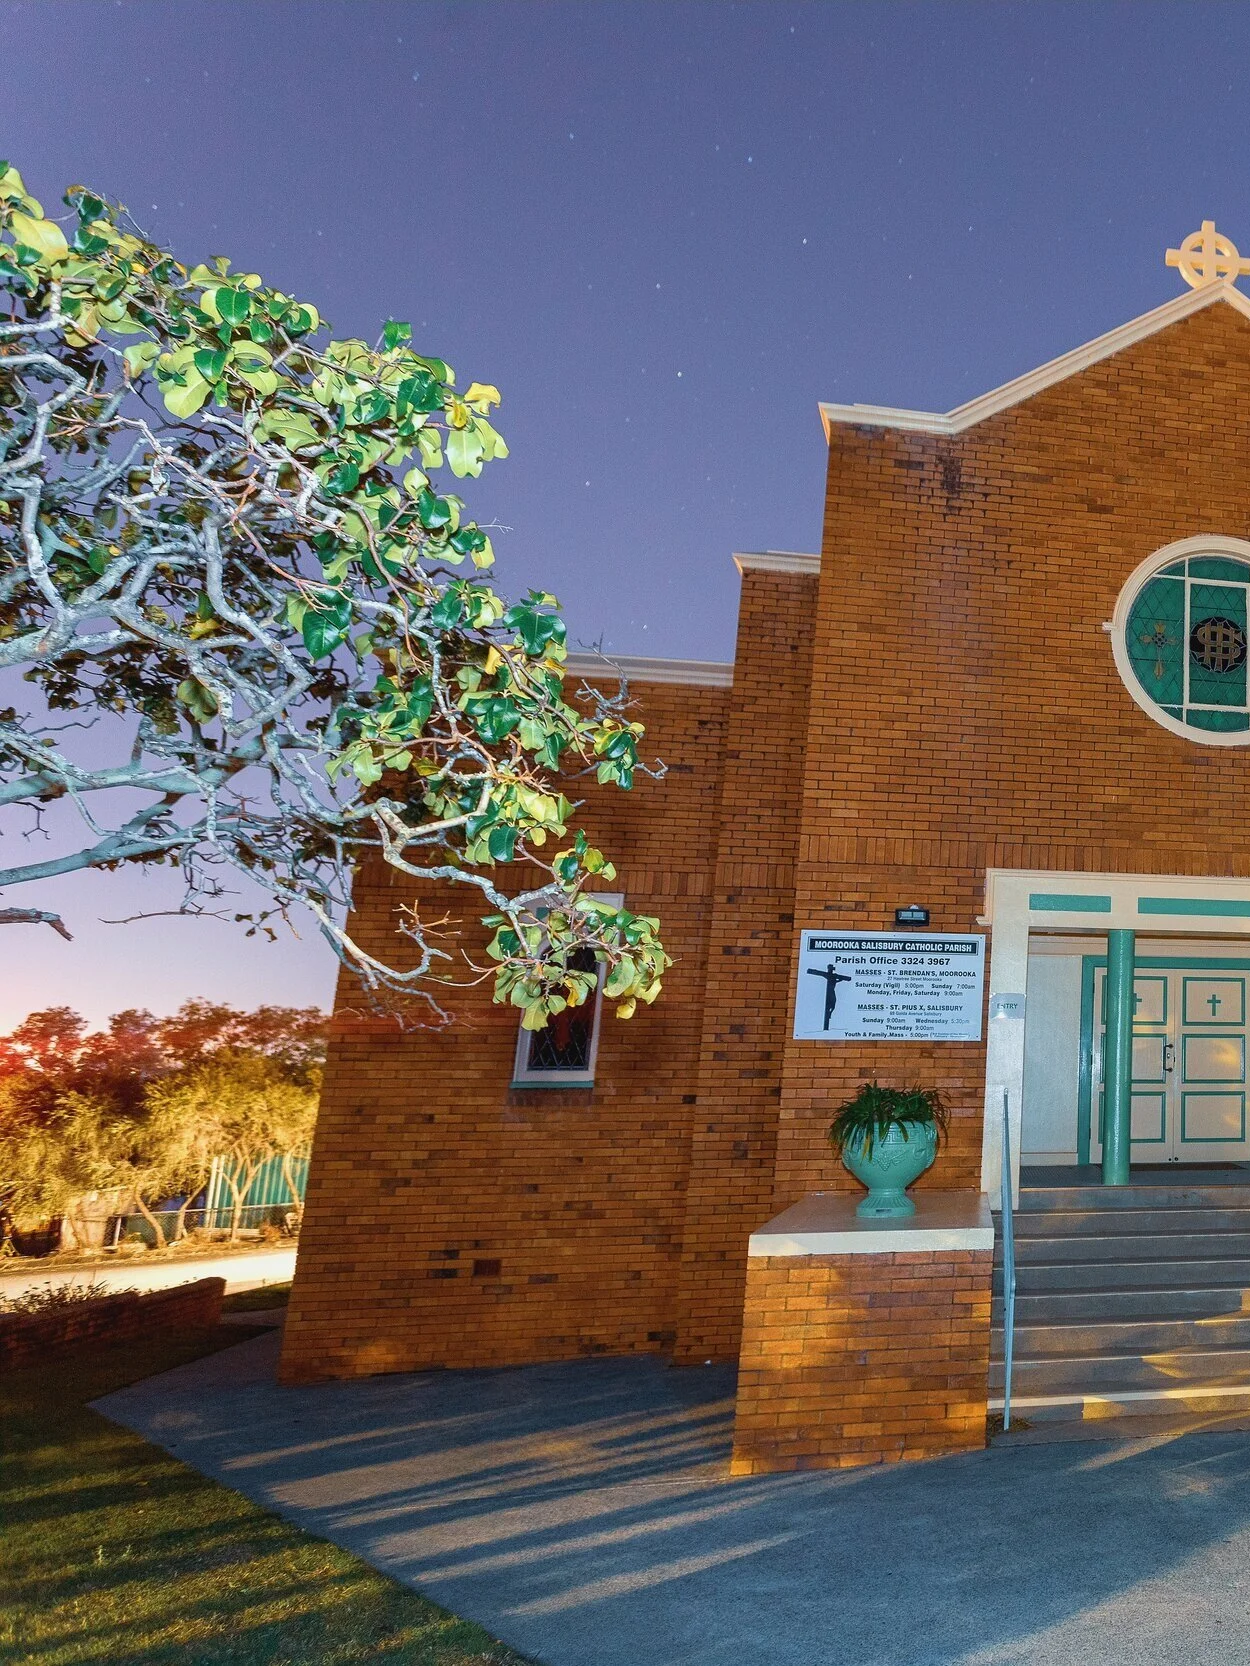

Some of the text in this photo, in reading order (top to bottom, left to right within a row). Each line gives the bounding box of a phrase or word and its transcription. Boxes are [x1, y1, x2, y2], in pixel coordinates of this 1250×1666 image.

[815, 940, 972, 952] MOOROOKA SALISBURY CATHOLIC PARISH
[835, 956, 951, 966] Parish Office 3324 3967
[892, 989, 913, 997] Friday,
